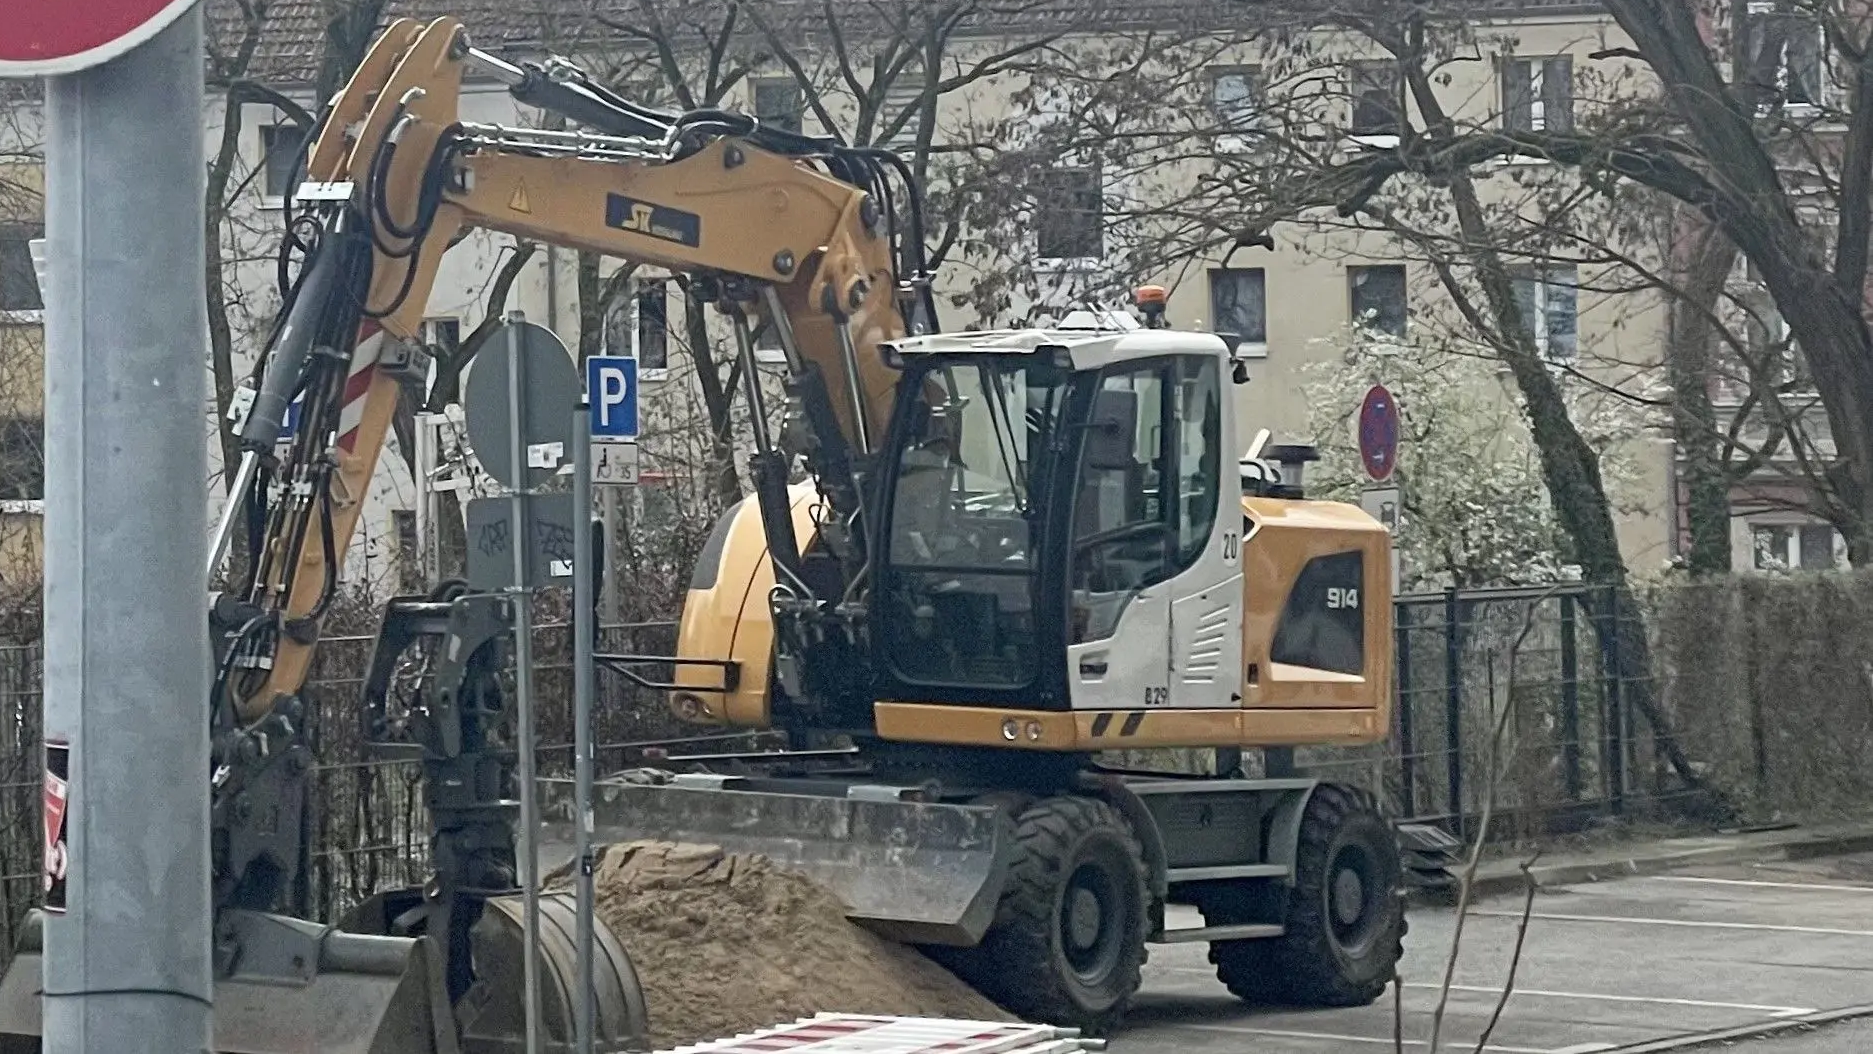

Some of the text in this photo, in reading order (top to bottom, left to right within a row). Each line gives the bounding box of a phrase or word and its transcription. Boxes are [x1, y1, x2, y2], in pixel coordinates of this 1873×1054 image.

[599, 367, 627, 427] P
[1223, 533, 1238, 560] 20
[1326, 587, 1359, 609] 914
